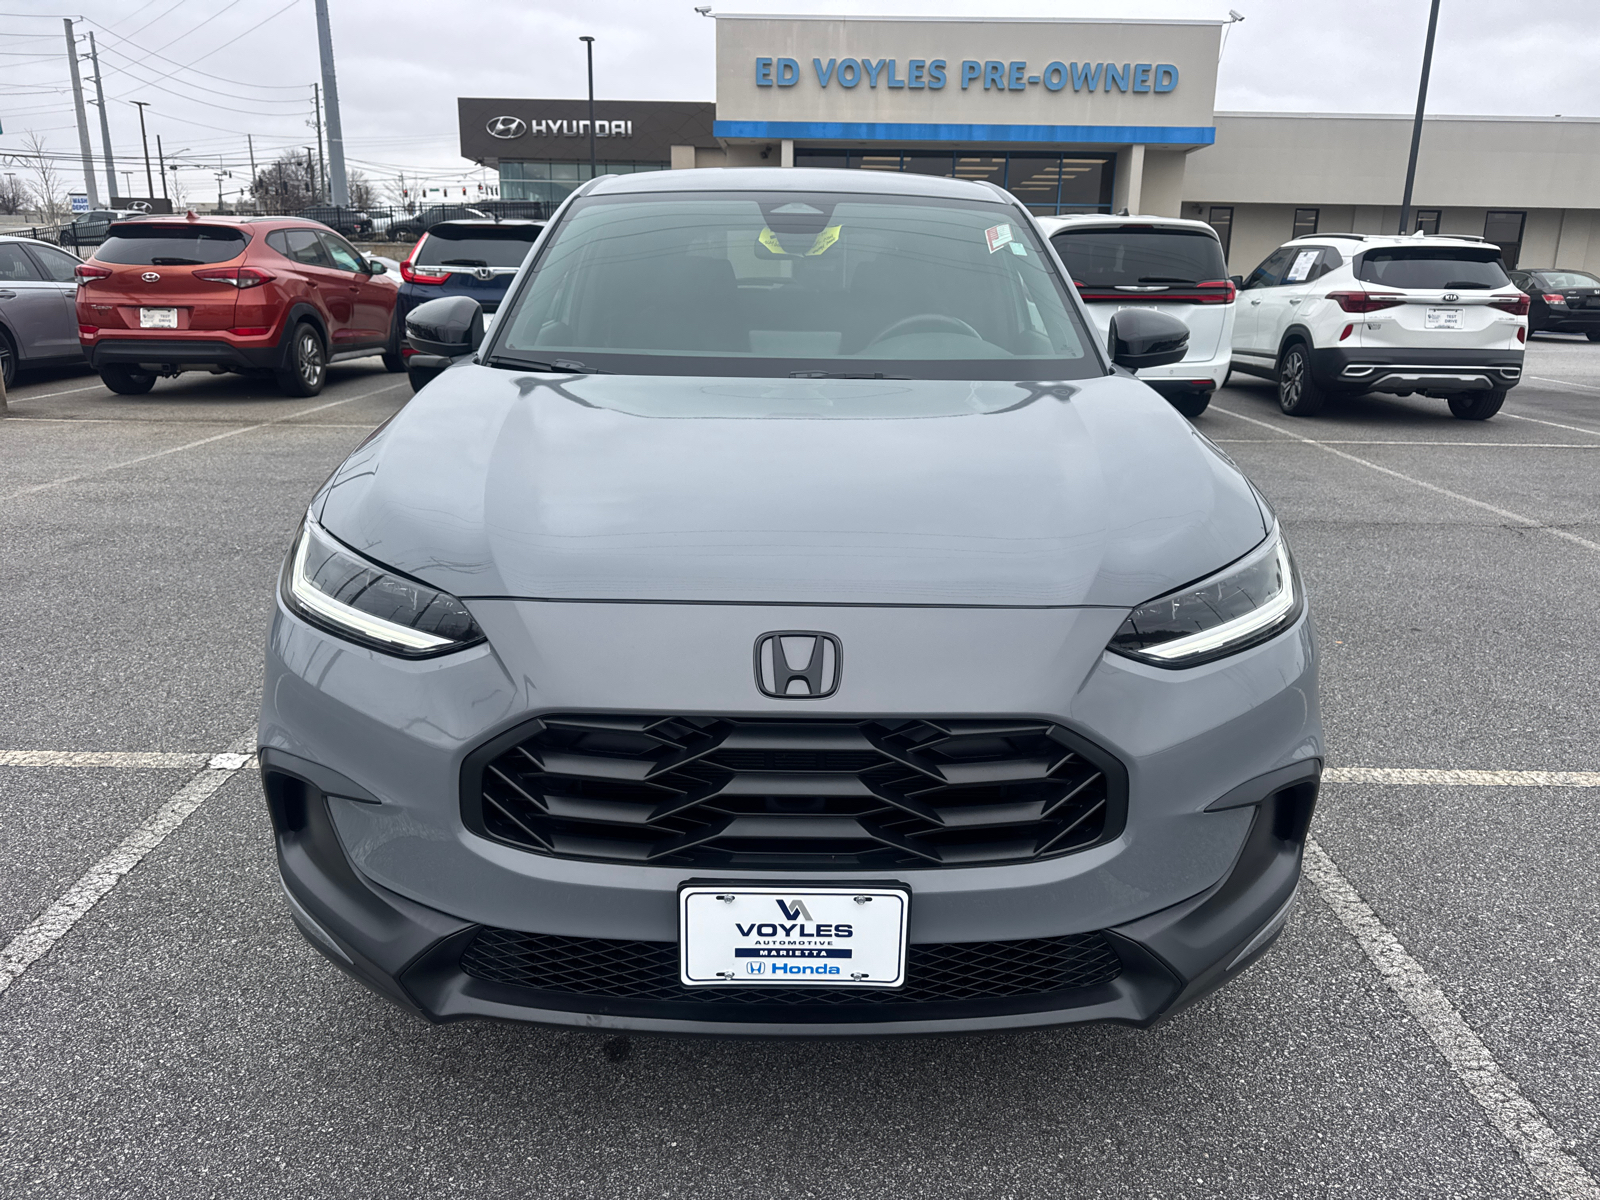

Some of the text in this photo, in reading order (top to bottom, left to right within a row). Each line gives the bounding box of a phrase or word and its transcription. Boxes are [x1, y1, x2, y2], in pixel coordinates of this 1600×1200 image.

[755, 57, 1180, 94] ED VOYLES PRE-OWNED
[531, 119, 633, 137] HYUNDAI
[735, 923, 853, 938] VOYLES
[771, 963, 841, 975] Honda
